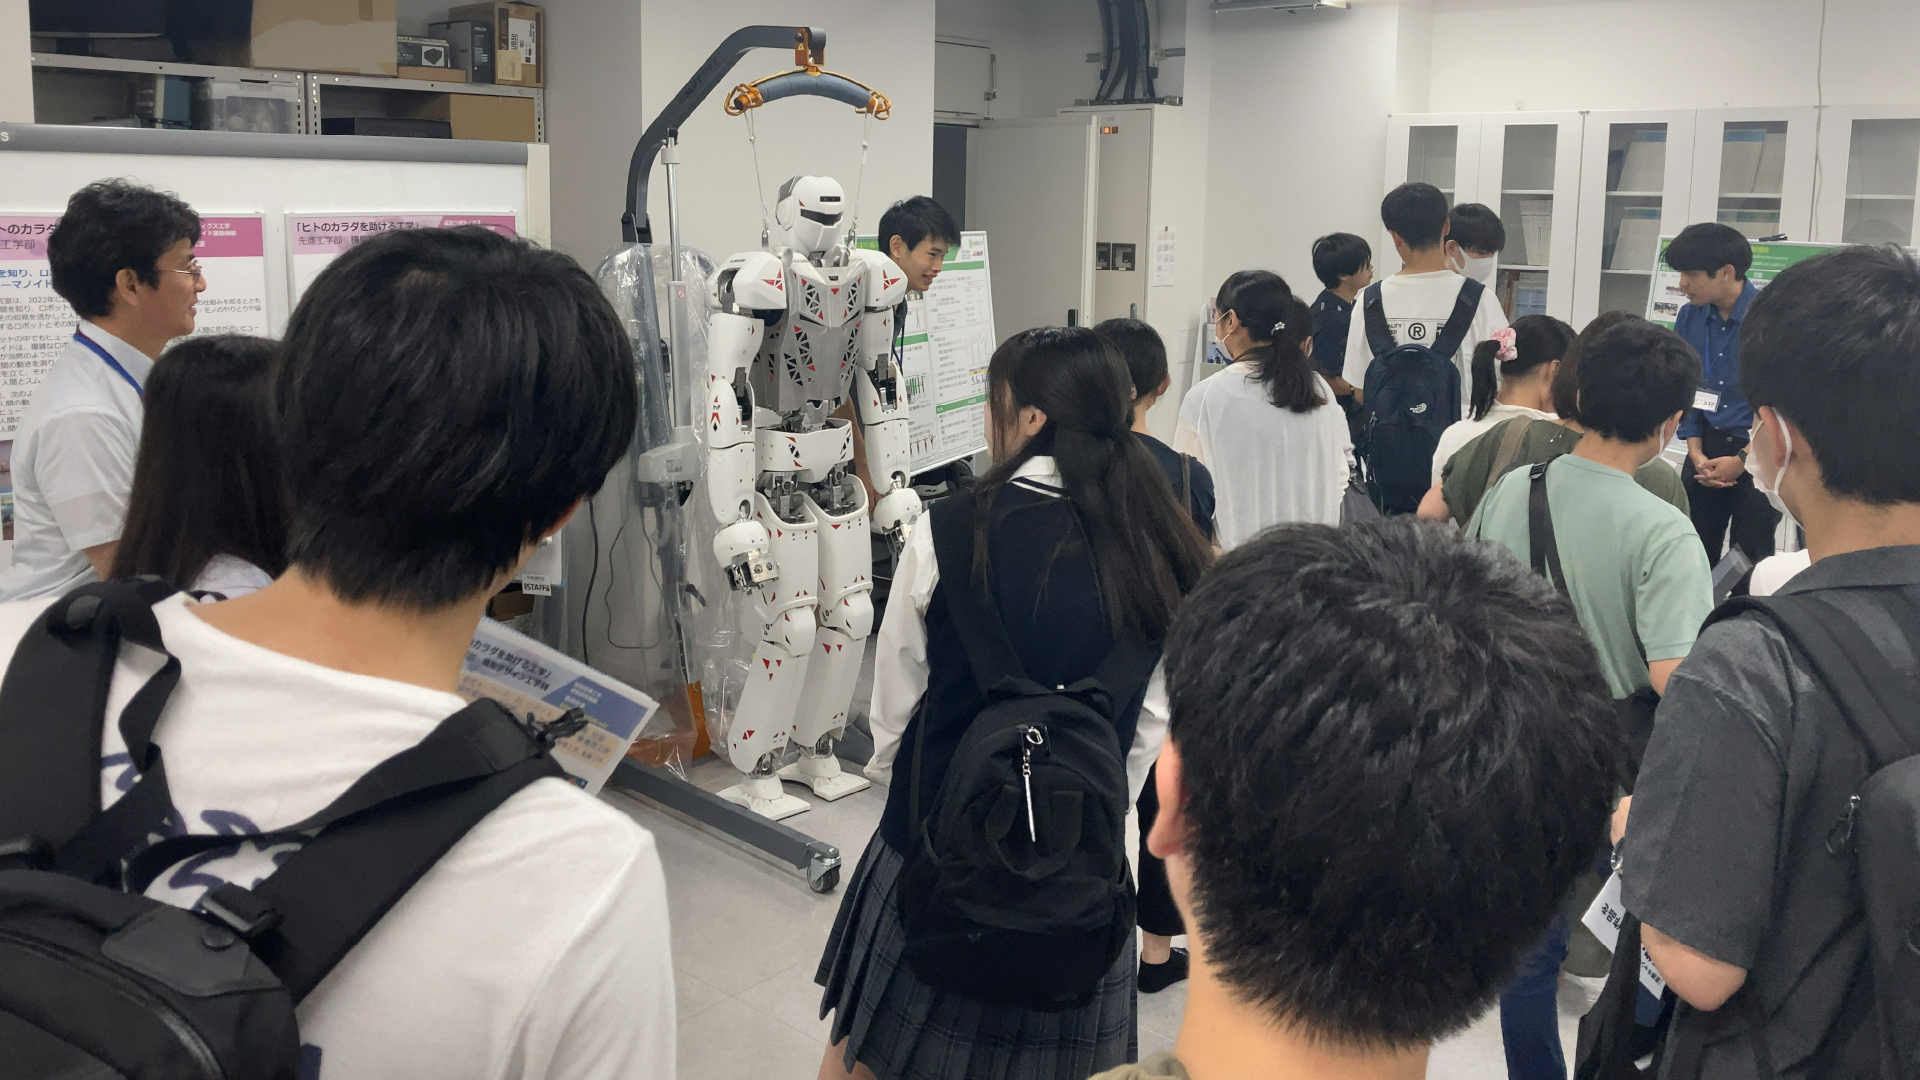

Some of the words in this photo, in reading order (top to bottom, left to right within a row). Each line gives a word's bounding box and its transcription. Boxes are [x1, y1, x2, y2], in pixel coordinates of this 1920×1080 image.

[298, 235, 343, 245] 先進工学部
